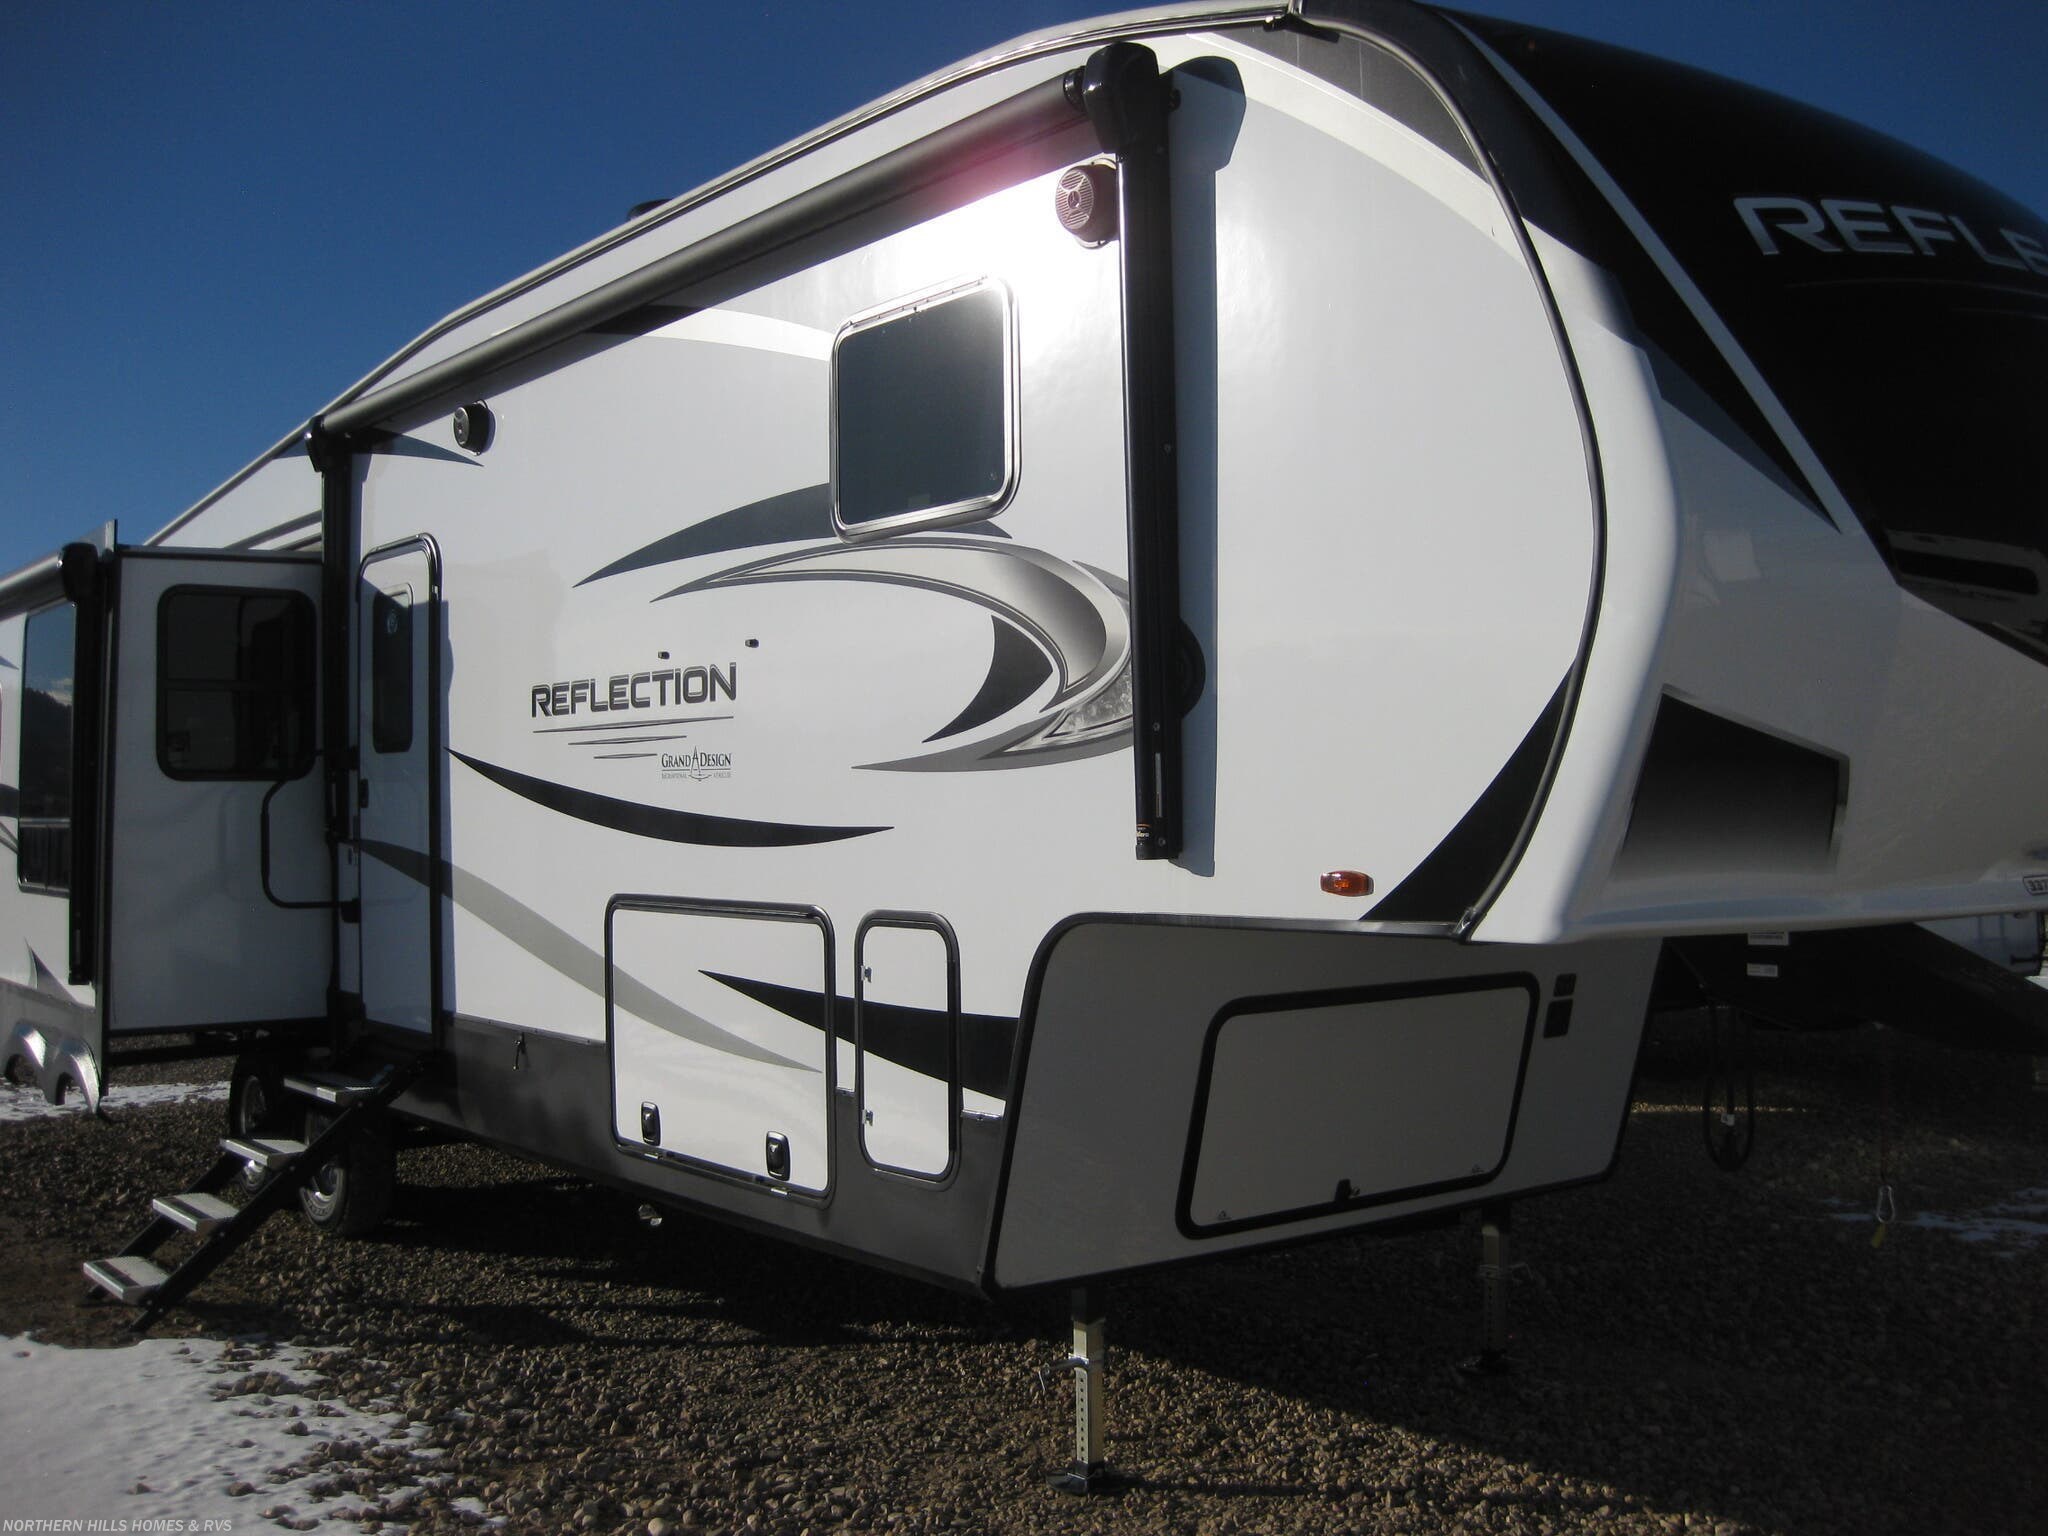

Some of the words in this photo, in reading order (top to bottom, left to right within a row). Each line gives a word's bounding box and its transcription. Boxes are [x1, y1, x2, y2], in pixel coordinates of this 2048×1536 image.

[531, 662, 737, 718] REFLECTION
[661, 753, 691, 768] GRAND
[700, 752, 732, 767] DESIGN
